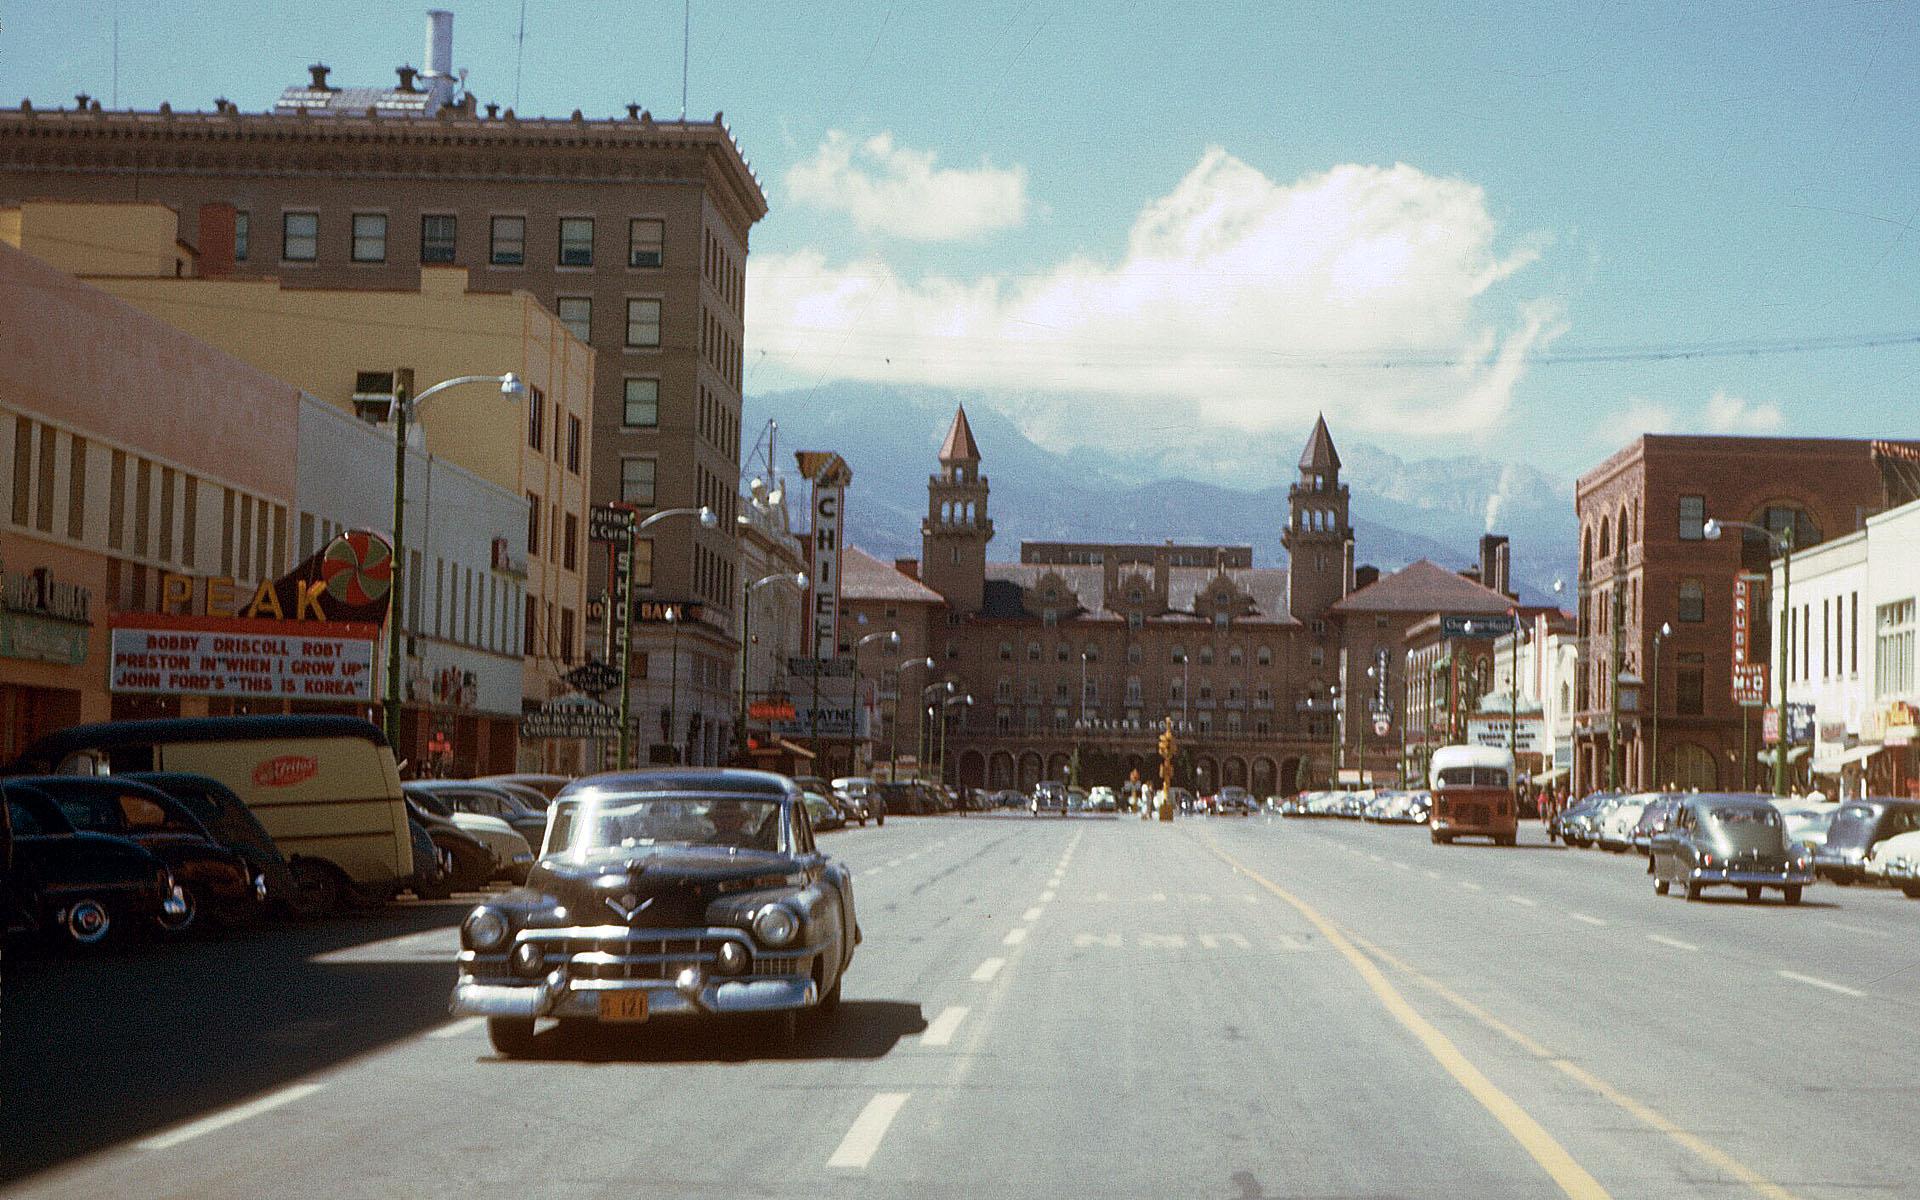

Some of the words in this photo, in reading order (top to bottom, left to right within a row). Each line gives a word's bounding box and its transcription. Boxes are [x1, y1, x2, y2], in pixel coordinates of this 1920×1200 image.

[815, 497, 836, 644] CHIEF
[162, 574, 328, 622] PEAK
[1735, 582, 1745, 662] DRUGS
[147, 635, 199, 652] BOBBY
[213, 638, 290, 656] DRISCOLL
[302, 642, 344, 658] ROBT
[115, 653, 190, 671] PRESTON
[200, 656, 217, 672] IN
[278, 659, 284, 673] I
[291, 660, 335, 676] GROW
[116, 672, 161, 689] JOHN
[169, 673, 226, 691] FORD'S
[281, 679, 296, 693] IS
[1074, 719, 1140, 730] ANTLERS
[1148, 720, 1193, 733] HOTEL
